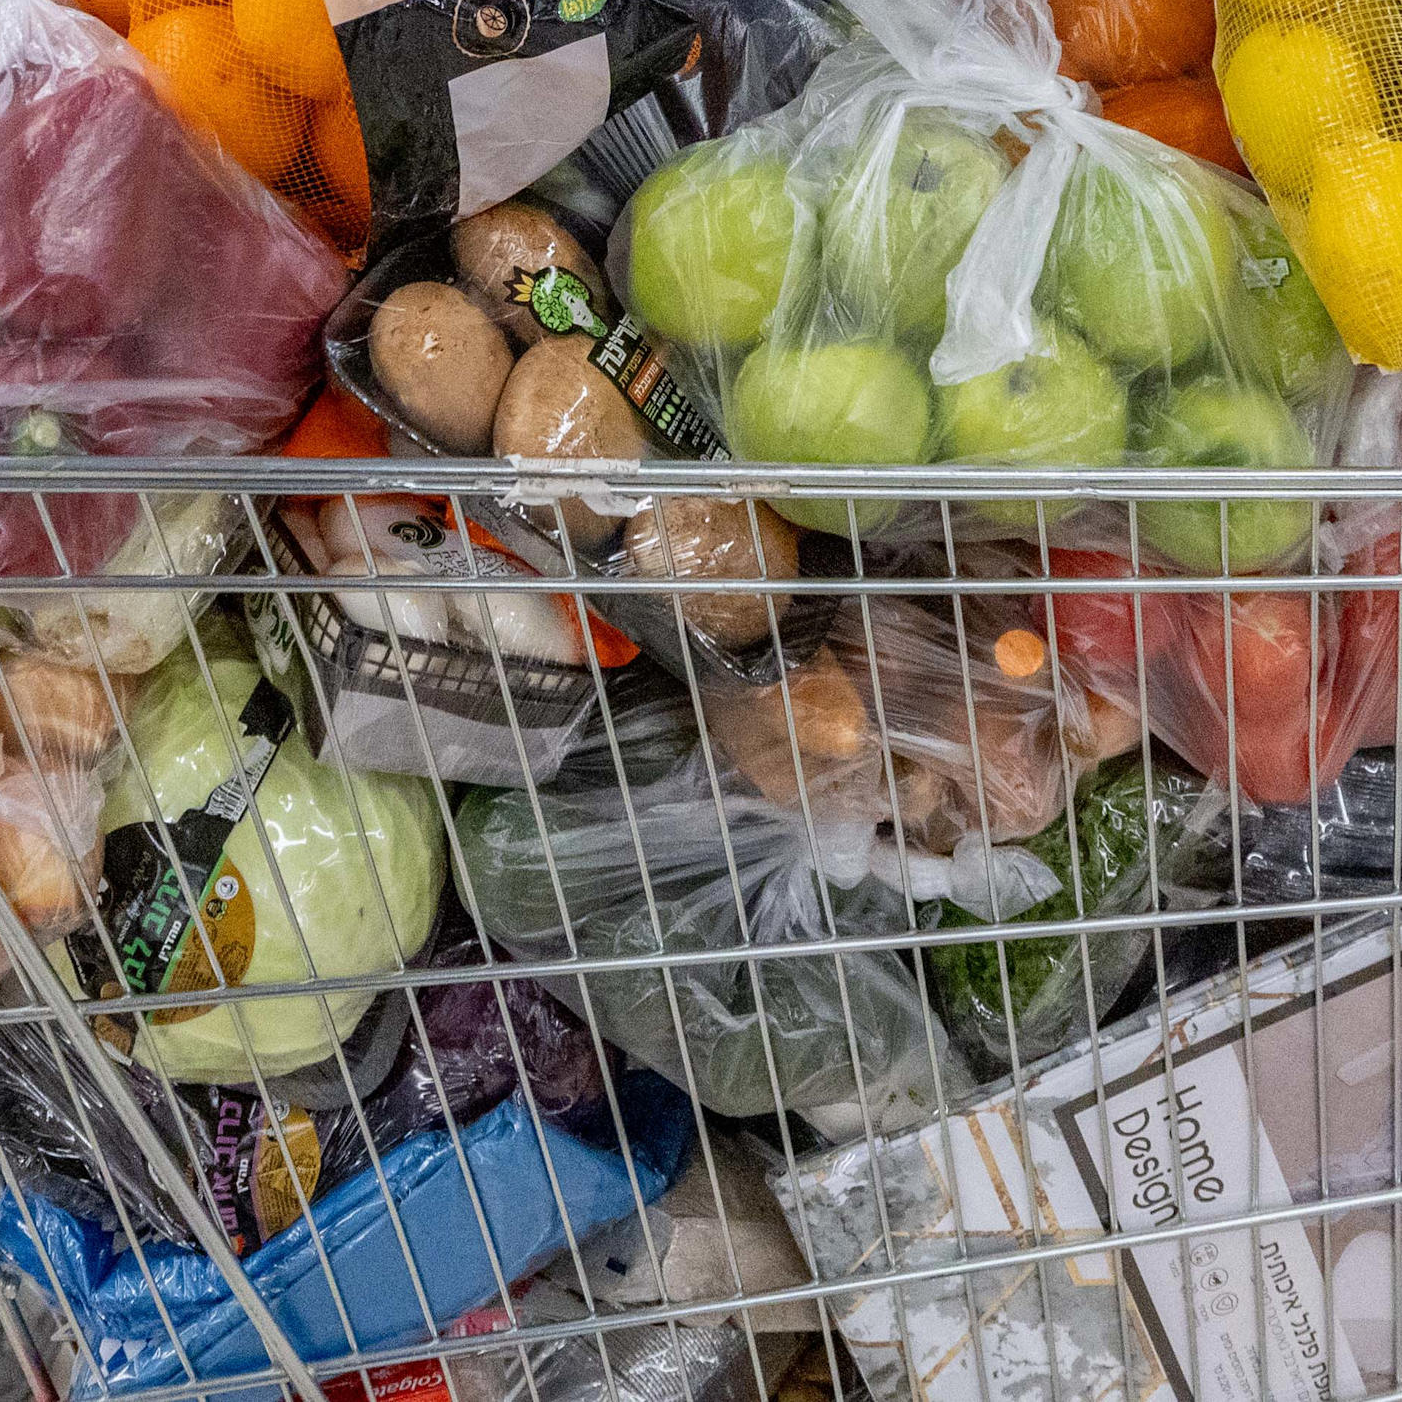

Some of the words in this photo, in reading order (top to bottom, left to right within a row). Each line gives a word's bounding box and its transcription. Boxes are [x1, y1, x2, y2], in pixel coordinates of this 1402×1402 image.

[633, 361, 660, 399] פורטבלה
[142, 867, 182, 937] כרוב
[123, 935, 154, 992] לבן
[157, 919, 183, 962] מהדרין
[216, 1101, 244, 1164] כרוב
[1156, 1085, 1225, 1203] Home
[1112, 1107, 1181, 1227] Design
[1259, 1241, 1302, 1314] איכותית
[1290, 1311, 1320, 1360] פלנל
